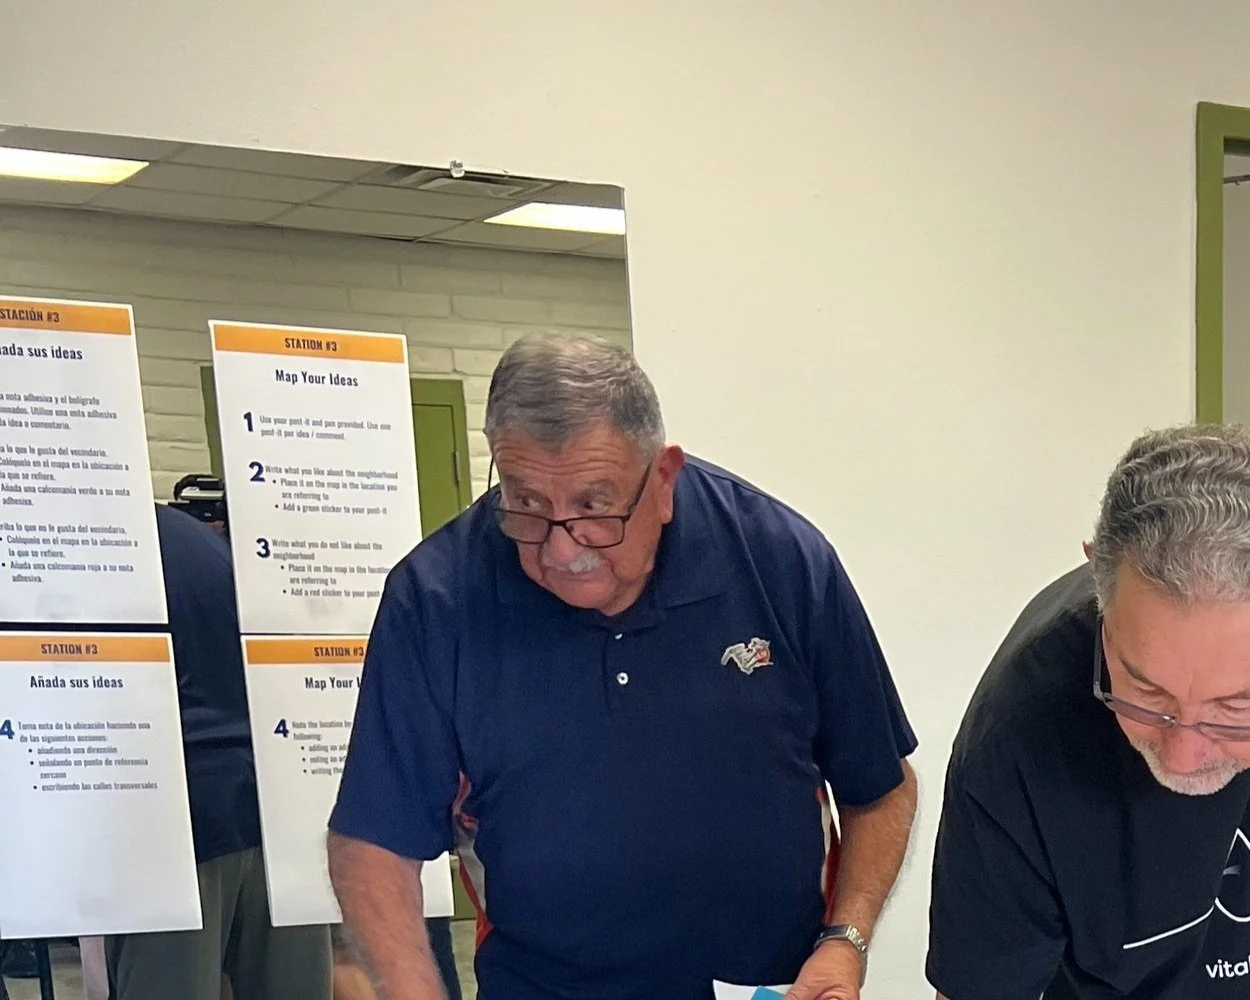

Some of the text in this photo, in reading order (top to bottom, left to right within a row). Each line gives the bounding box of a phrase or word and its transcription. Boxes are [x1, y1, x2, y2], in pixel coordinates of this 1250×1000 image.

[47, 312, 59, 322] #3
[285, 338, 337, 351] STATION #3
[28, 346, 47, 358] sus
[52, 346, 82, 360] ideas
[275, 369, 358, 387] Map Your Ideas
[243, 411, 253, 432] 1
[249, 461, 265, 482] 2
[256, 538, 270, 558] 3
[41, 644, 98, 655] STATION #3
[314, 647, 350, 657] STATION
[30, 675, 123, 688] Añada sus ideas
[305, 677, 326, 691] Map
[330, 677, 353, 688] Your
[0, 719, 15, 740] 4
[274, 718, 289, 738] 4
